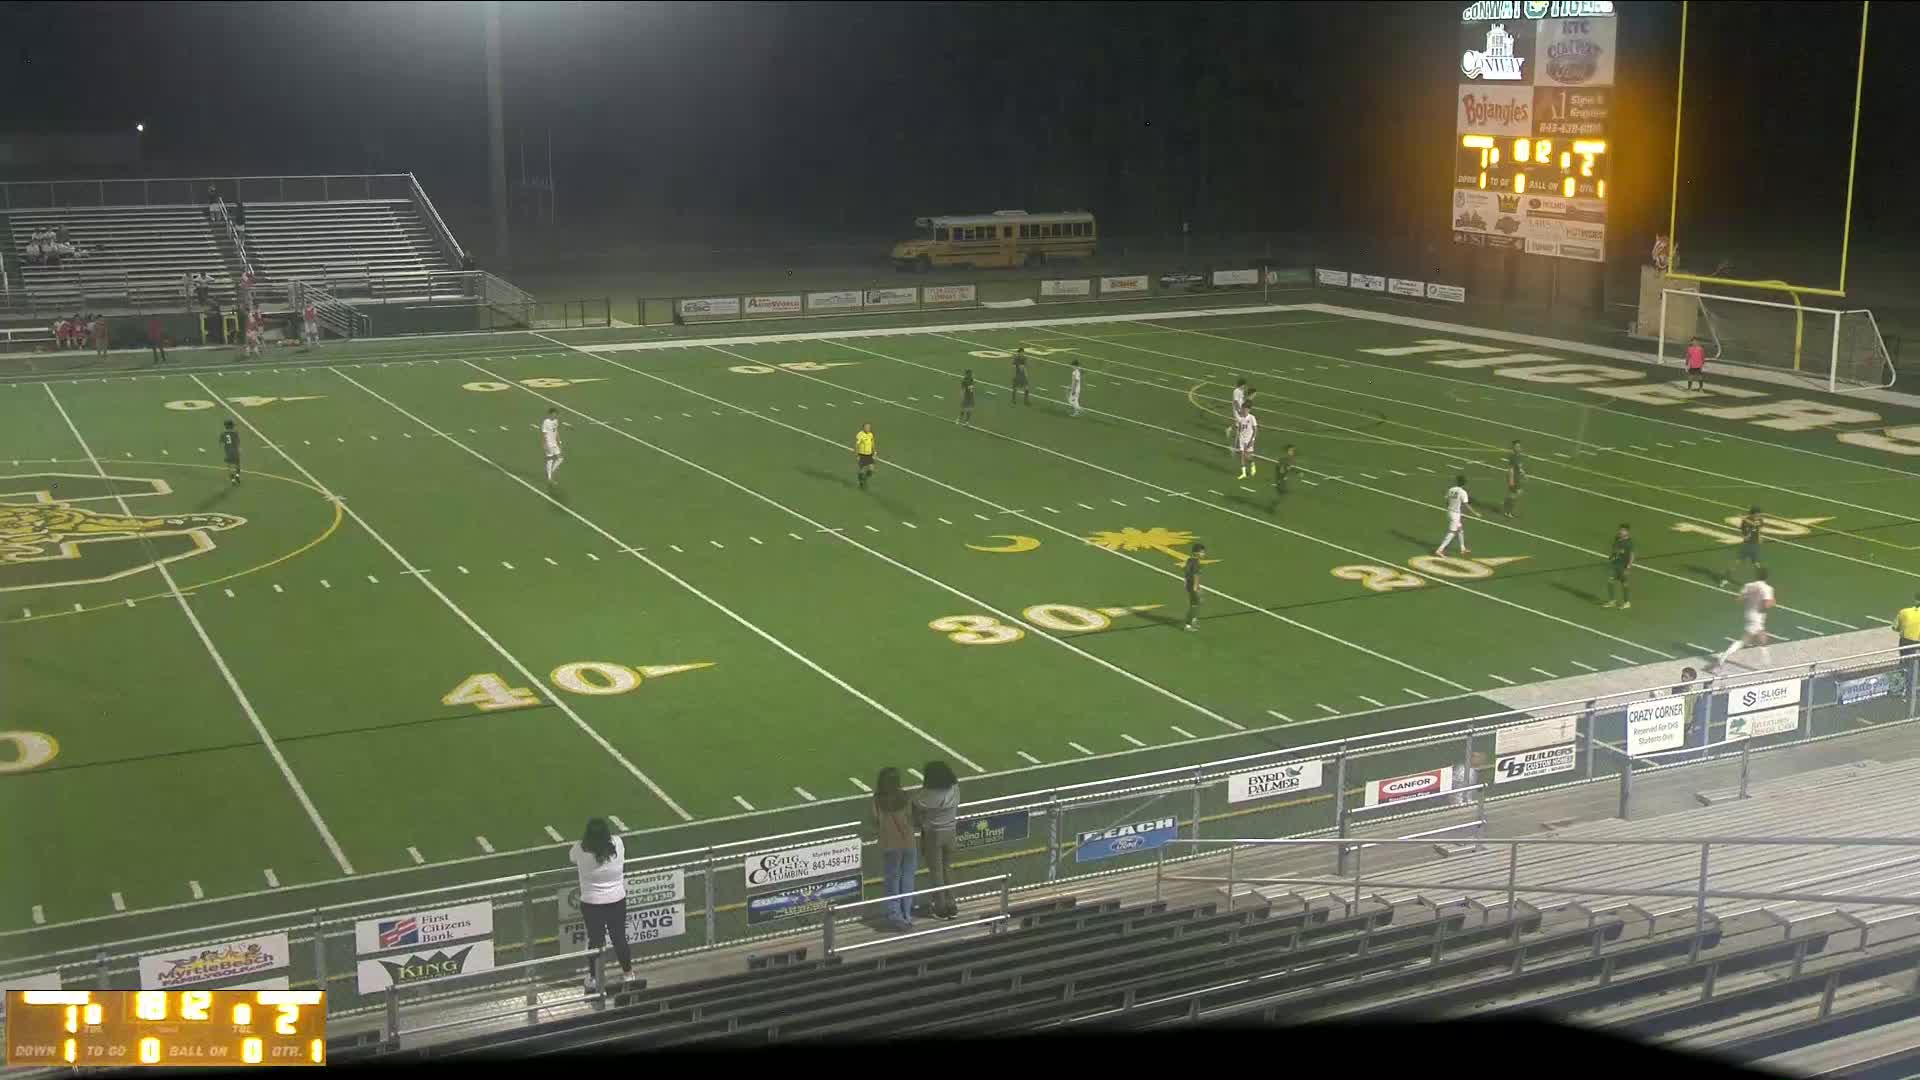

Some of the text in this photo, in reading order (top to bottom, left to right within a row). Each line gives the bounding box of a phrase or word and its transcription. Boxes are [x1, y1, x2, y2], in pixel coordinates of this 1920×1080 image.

[1463, 94, 1529, 127] Bojangles
[1330, 555, 1495, 592] 20
[928, 603, 1112, 645] 30
[440, 661, 643, 712] 40
[1761, 687, 1788, 699] SLIGH
[1629, 703, 1683, 723] CRAZY CORNER
[1525, 746, 1574, 762] BUILDERS
[1248, 771, 1285, 786] BYRD
[1248, 778, 1300, 795] PALMER
[1389, 778, 1431, 791] CANFOR
[812, 853, 859, 870] 843-458-4715
[627, 873, 673, 887] Country
[421, 919, 472, 934] Citizens
[422, 914, 449, 925] First
[421, 930, 454, 943] Bank
[399, 960, 458, 979] KING
